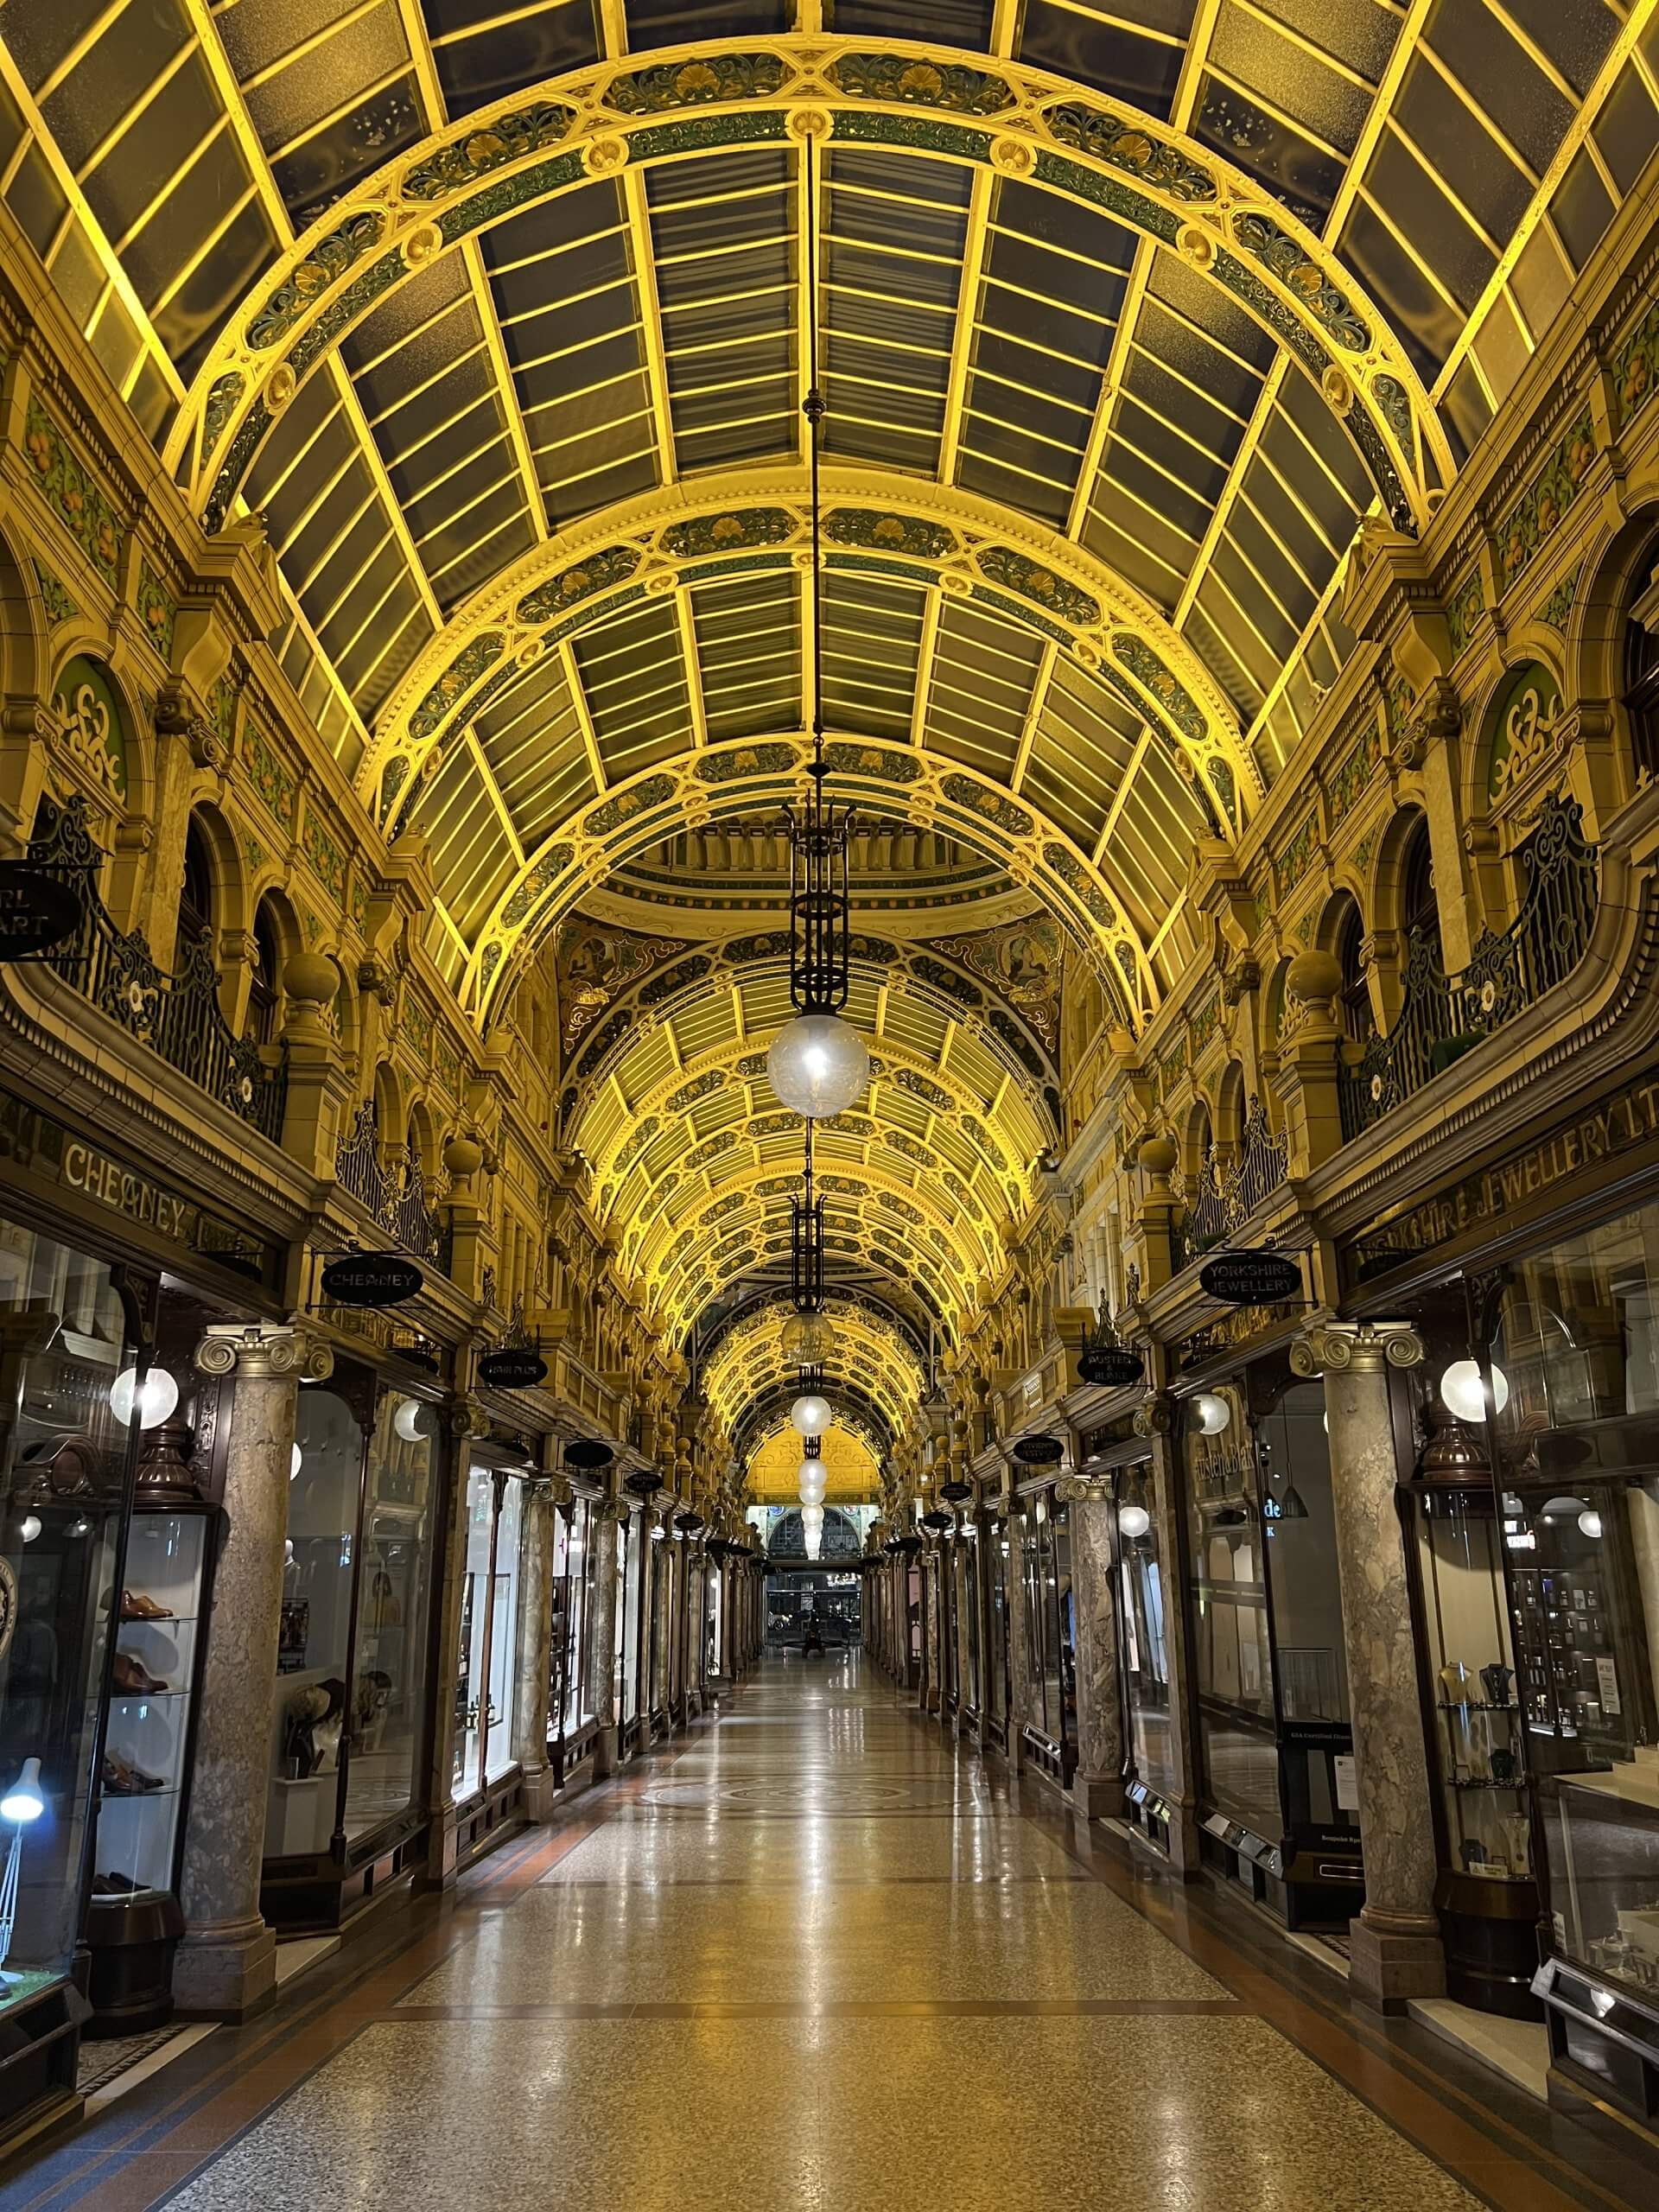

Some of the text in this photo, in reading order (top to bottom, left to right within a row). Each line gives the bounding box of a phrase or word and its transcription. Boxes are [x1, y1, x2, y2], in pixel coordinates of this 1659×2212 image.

[1478, 1107, 1613, 1217] JEWELLERY
[65, 1143, 186, 1236] CHEANEY
[1210, 1264, 1291, 1277] YORKSHIRE
[330, 1274, 414, 1287] CHEANEY
[1211, 1279, 1293, 1293] JEWELLERY
